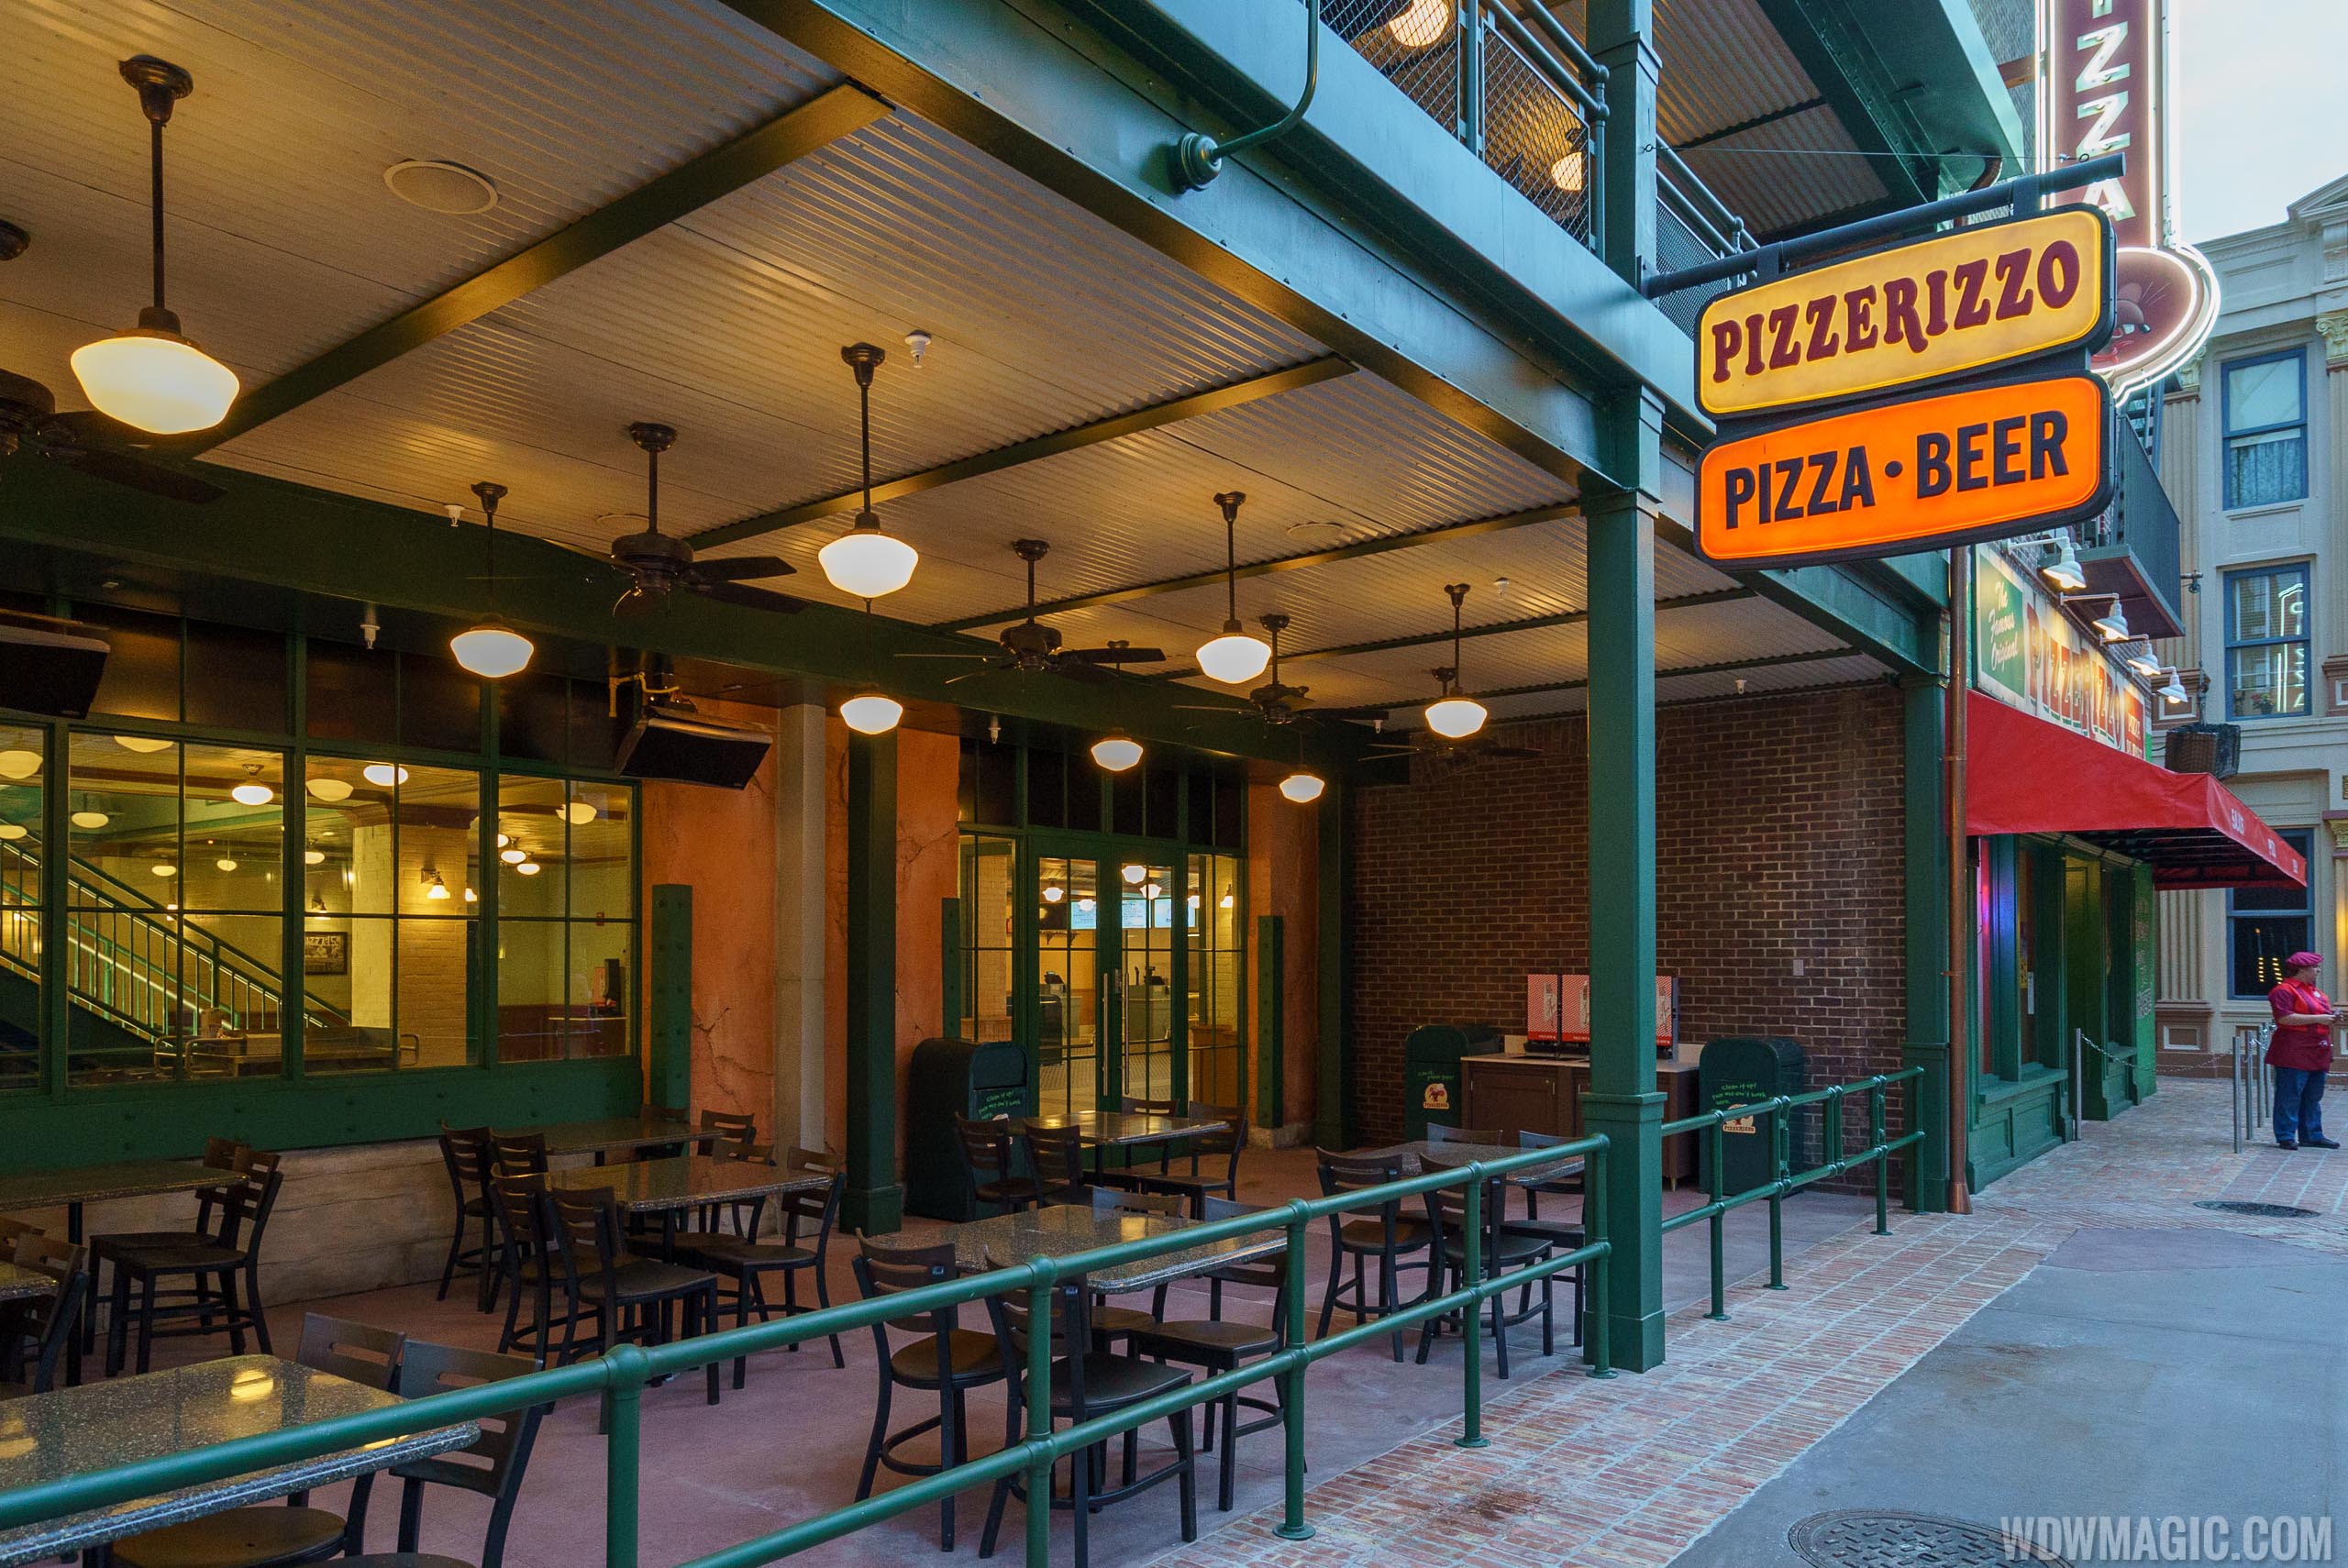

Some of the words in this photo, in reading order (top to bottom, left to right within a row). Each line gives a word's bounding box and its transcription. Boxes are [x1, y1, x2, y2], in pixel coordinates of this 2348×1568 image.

[1712, 240, 2080, 383] PIZZERIZZO
[1725, 446, 1876, 530] PIZZA
[1917, 410, 2069, 500] BEER
[1996, 580, 2009, 612] The
[1988, 608, 2015, 644] Famous
[1991, 631, 2019, 672] Original
